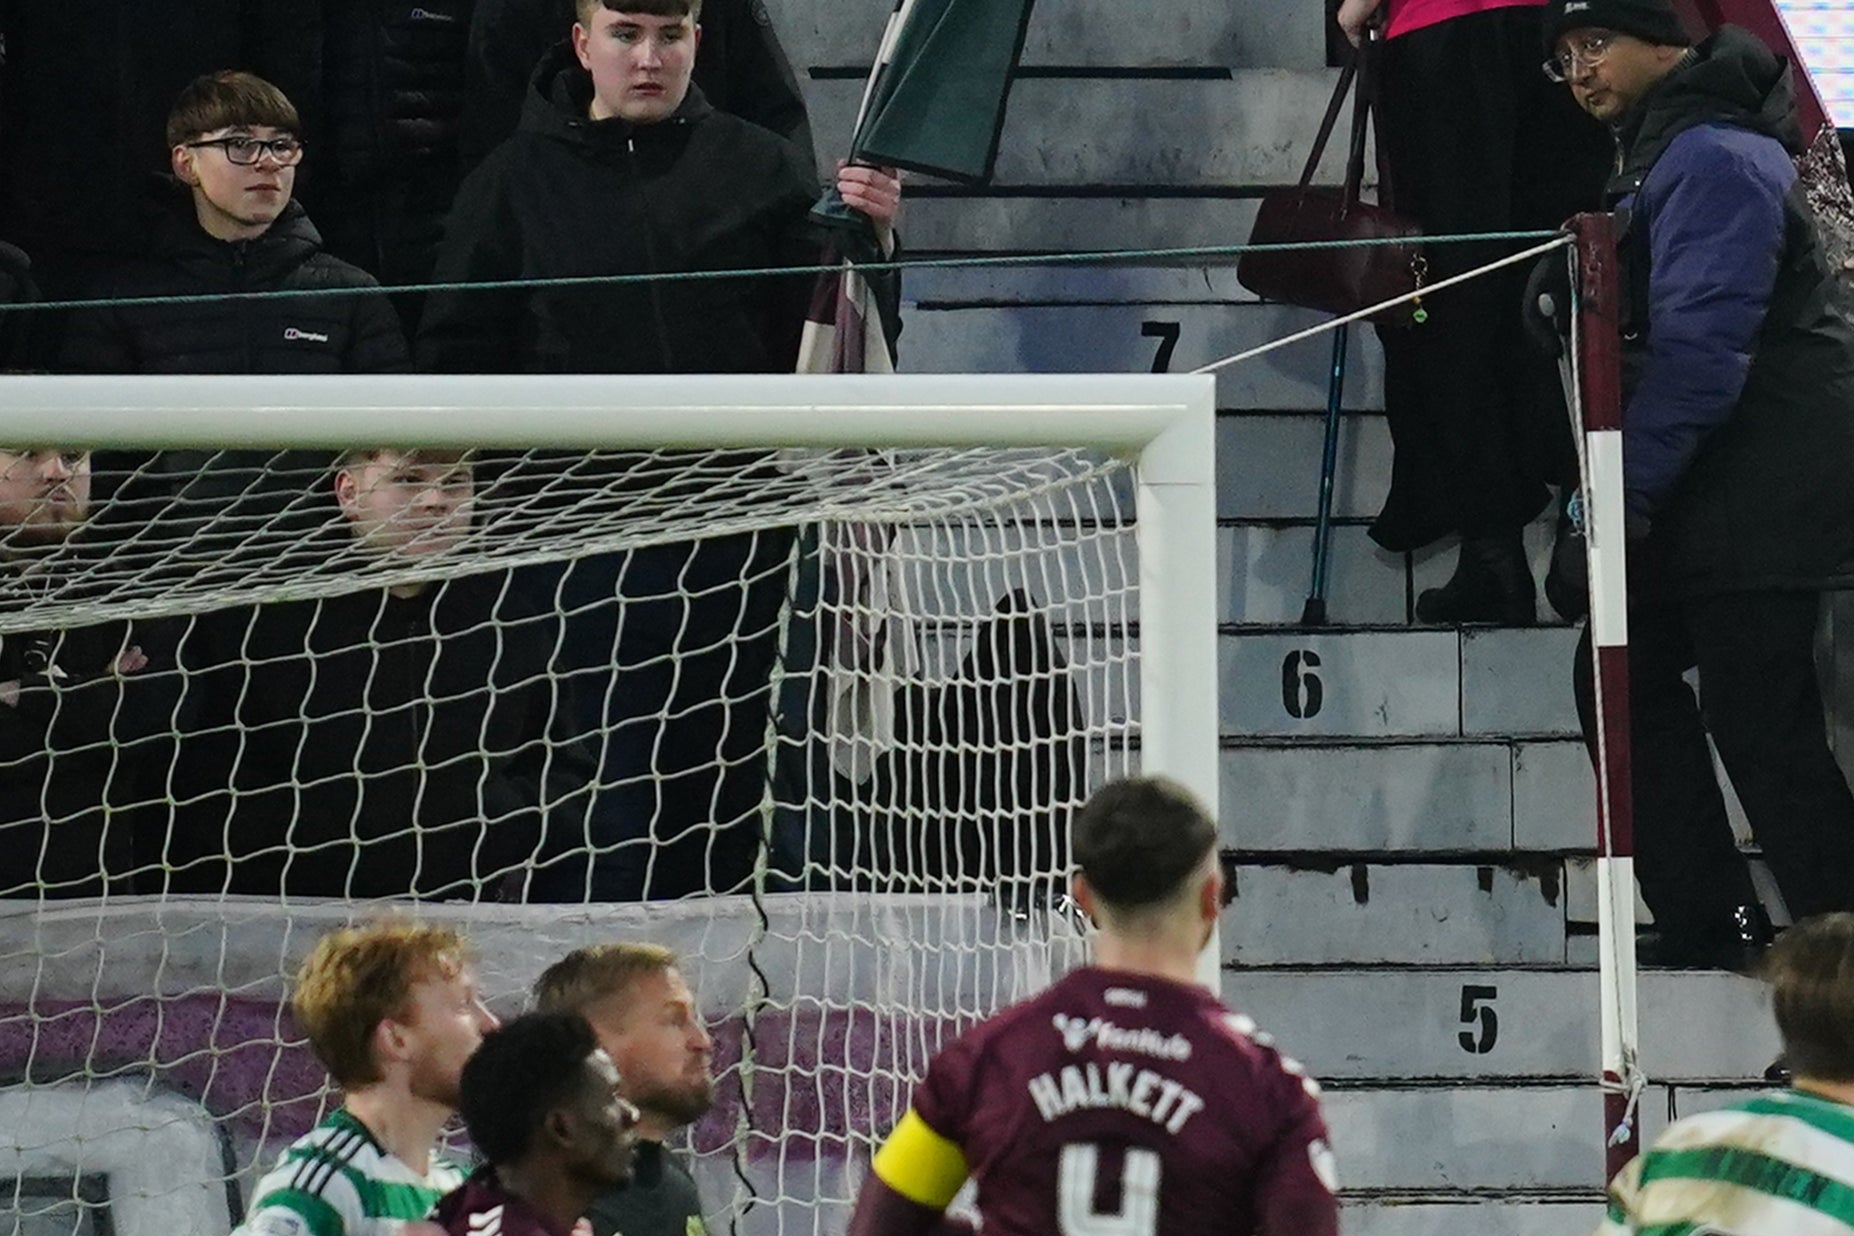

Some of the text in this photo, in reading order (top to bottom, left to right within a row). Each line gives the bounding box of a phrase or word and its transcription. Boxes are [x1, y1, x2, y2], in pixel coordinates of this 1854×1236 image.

[1141, 321, 1180, 374] 7
[1282, 650, 1323, 718] 6
[1458, 985, 1498, 1054] 5
[1029, 1060, 1206, 1135] HALKETT
